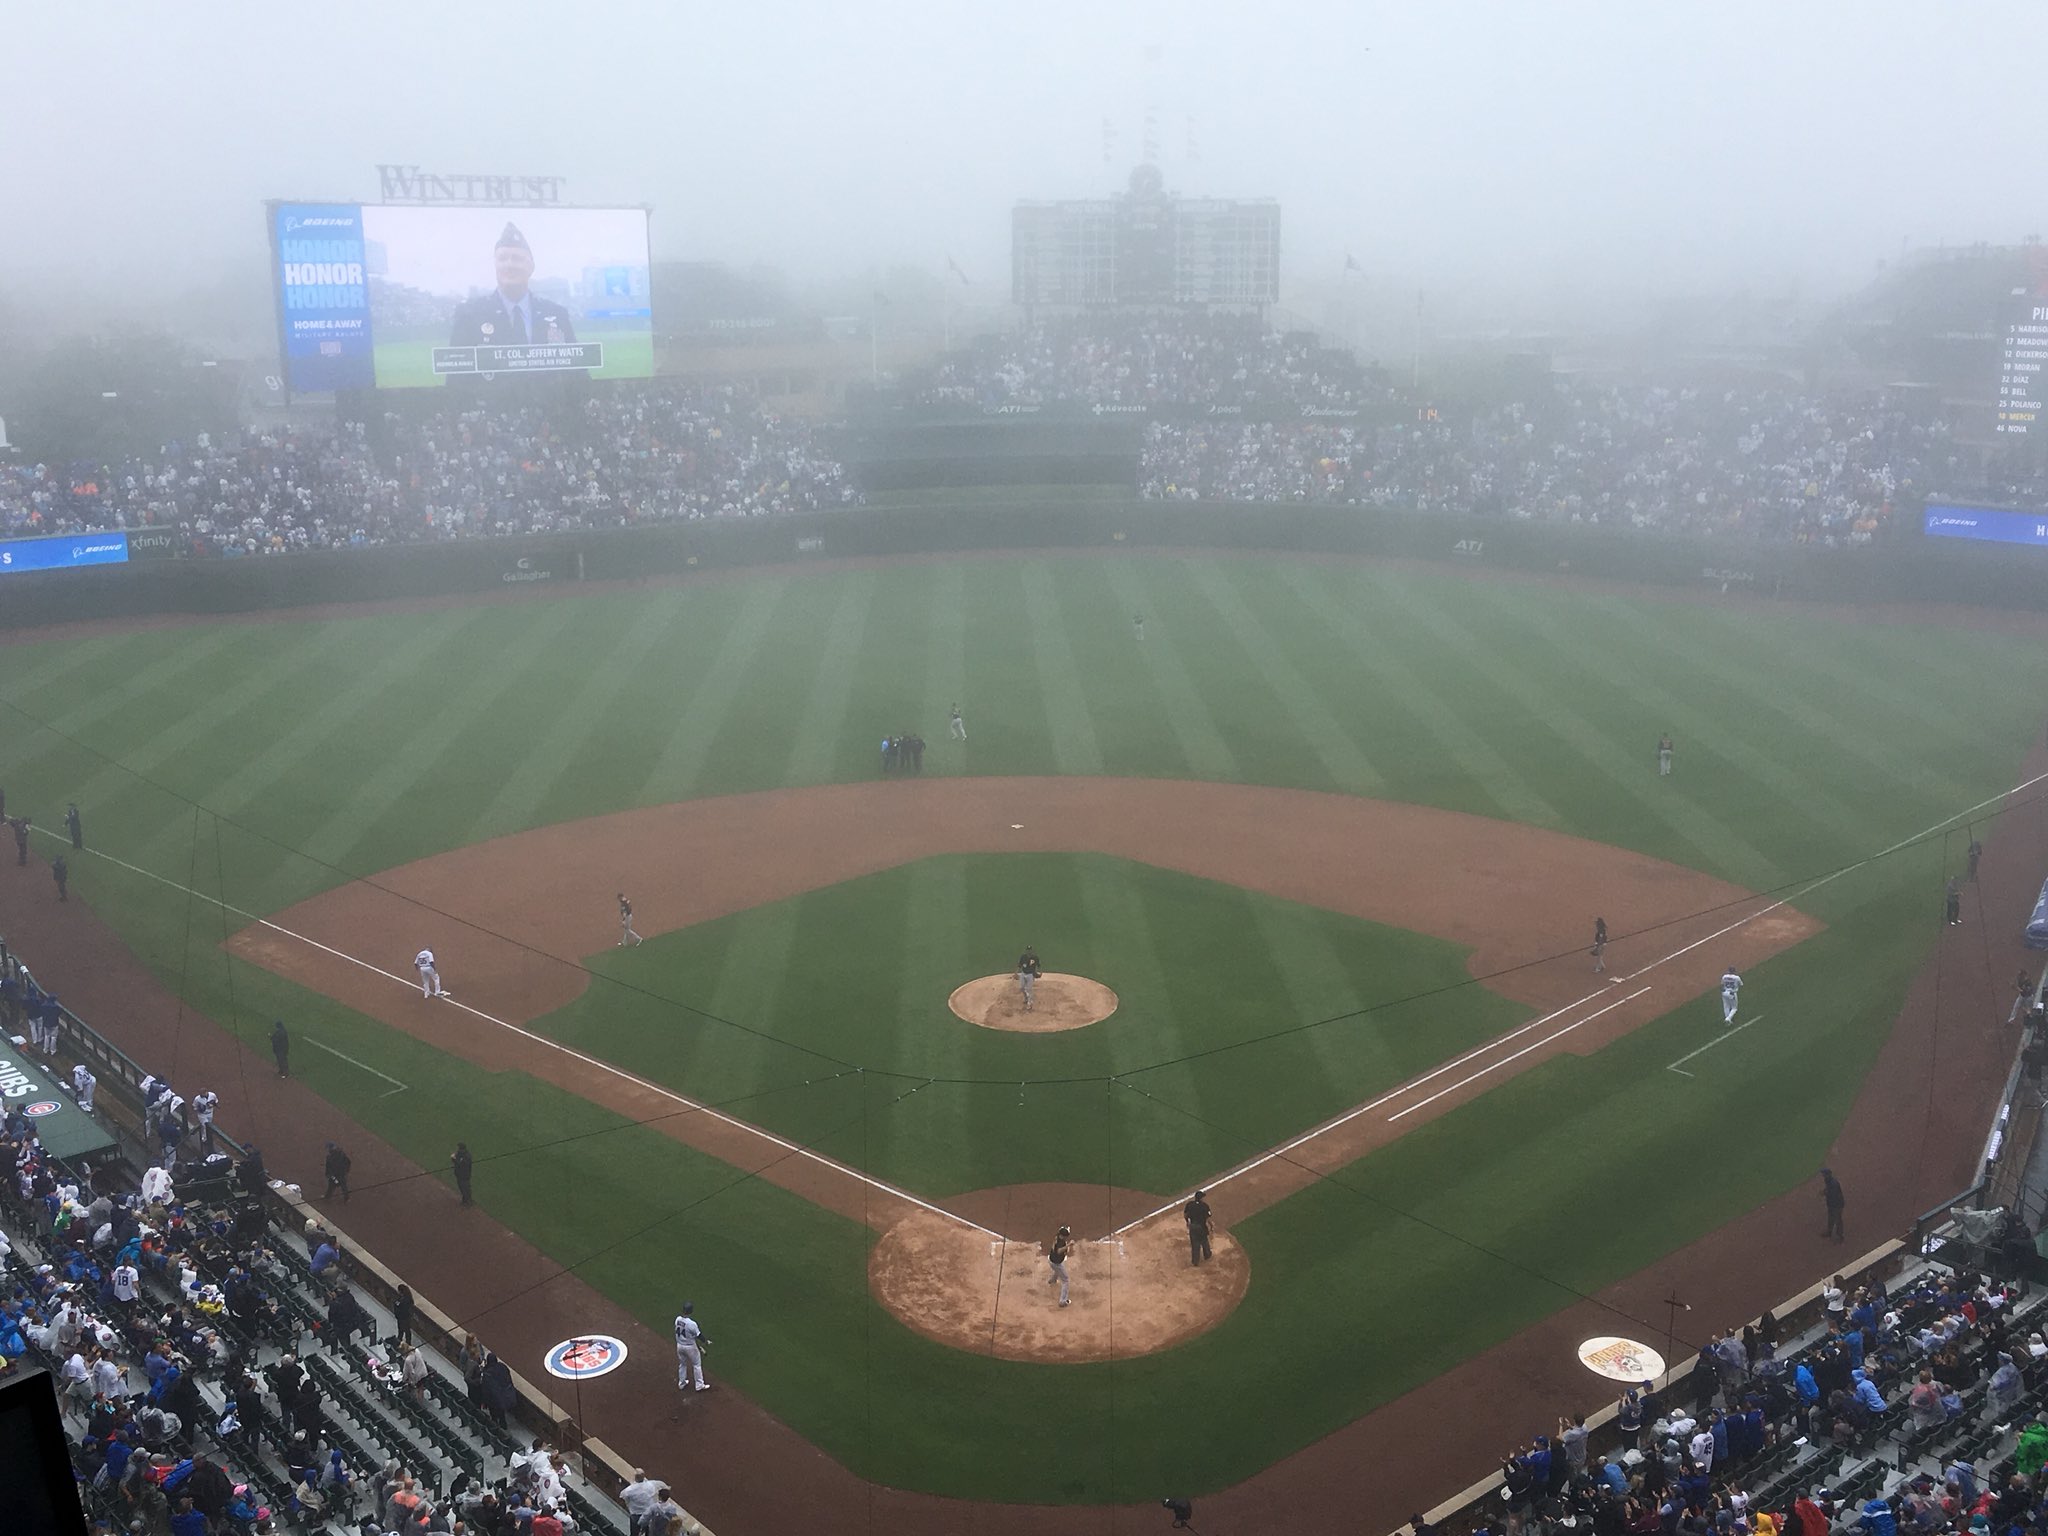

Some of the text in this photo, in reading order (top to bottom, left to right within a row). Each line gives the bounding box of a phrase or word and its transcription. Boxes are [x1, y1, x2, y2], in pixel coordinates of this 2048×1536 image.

[375, 164, 567, 200] WINTRUST
[302, 218, 354, 226] BOEING
[283, 239, 360, 261] HONOR
[284, 263, 363, 285] HONOR
[286, 286, 365, 309] HONOR
[294, 320, 326, 329] HOME
[334, 320, 362, 329] AWAY
[2019, 325, 2048, 333] HARRISO
[527, 348, 556, 358] JEFFERY
[558, 347, 584, 357] WATTS
[2016, 350, 2048, 358] DICKERSO
[2014, 363, 2040, 371] MORAN
[1104, 404, 1147, 413] Advocate
[1941, 518, 1978, 526] BOEING
[131, 535, 172, 550] xfinity
[0, 544, 122, 564] S BOEING
[503, 570, 551, 582] Gallagher
[118, 1275, 129, 1287] 18
[676, 1326, 686, 1339] 44
